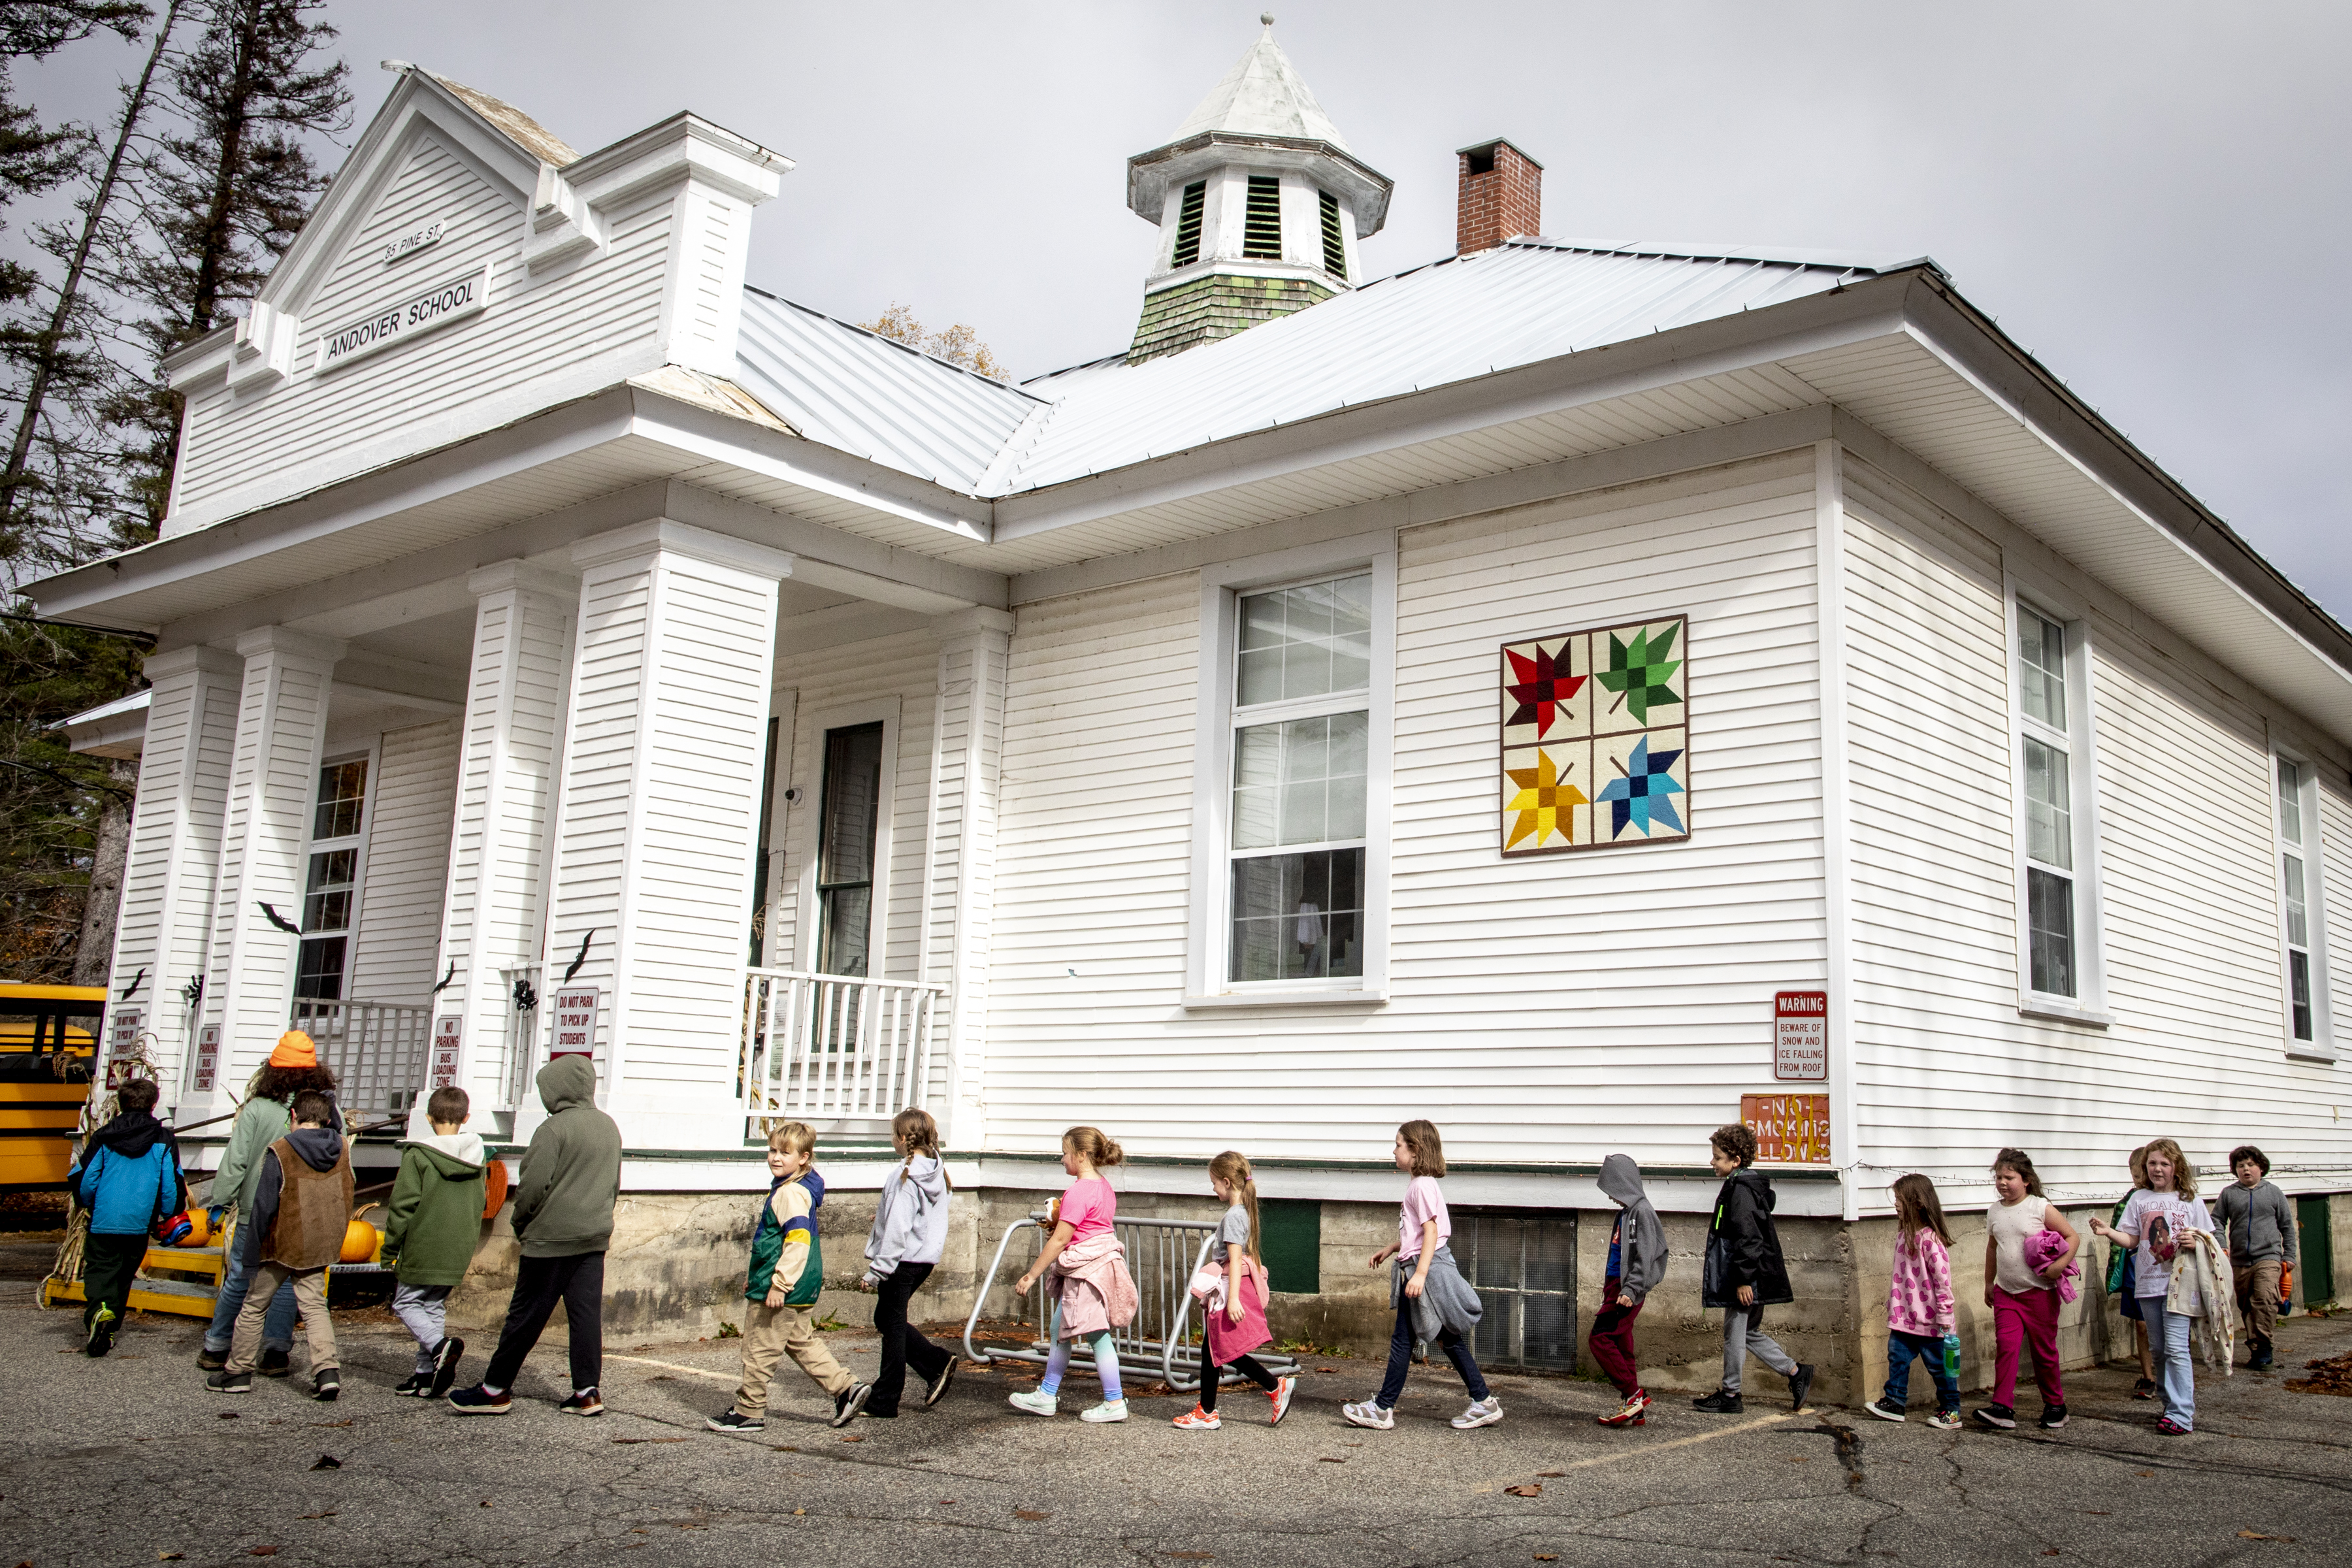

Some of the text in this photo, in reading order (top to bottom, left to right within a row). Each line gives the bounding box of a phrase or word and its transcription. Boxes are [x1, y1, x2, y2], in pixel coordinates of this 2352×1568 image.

[385, 244, 397, 259] 85
[399, 231, 423, 253] PINE
[327, 282, 473, 360] ANDOVER SCHOOL
[559, 995, 594, 1008] DO NOT PARK
[1779, 997, 1823, 1011] WARNING
[116, 1016, 122, 1026] DO
[129, 1015, 138, 1025] PARK
[561, 1014, 589, 1026] TO PICK UP
[445, 1021, 453, 1034] NO
[1780, 1023, 1821, 1032] BEWARE OF
[116, 1030, 122, 1040] TO
[129, 1030, 134, 1039] UP
[207, 1030, 214, 1041] NO
[559, 1032, 586, 1045] STUDENTS
[1782, 1036, 1820, 1045] SNOW AND
[436, 1035, 459, 1048] PARKING
[199, 1043, 218, 1054] PARKING
[1778, 1050, 1823, 1058] ICE FALLING
[202, 1058, 211, 1068] BUS
[440, 1053, 451, 1063] BUS
[433, 1064, 456, 1075] LOADING
[1780, 1063, 1821, 1071] FROM ROOF
[196, 1068, 214, 1078] LOADING
[198, 1079, 210, 1088] ZONE
[436, 1076, 450, 1086] ZONE
[2137, 1200, 2189, 1215] MOANA
